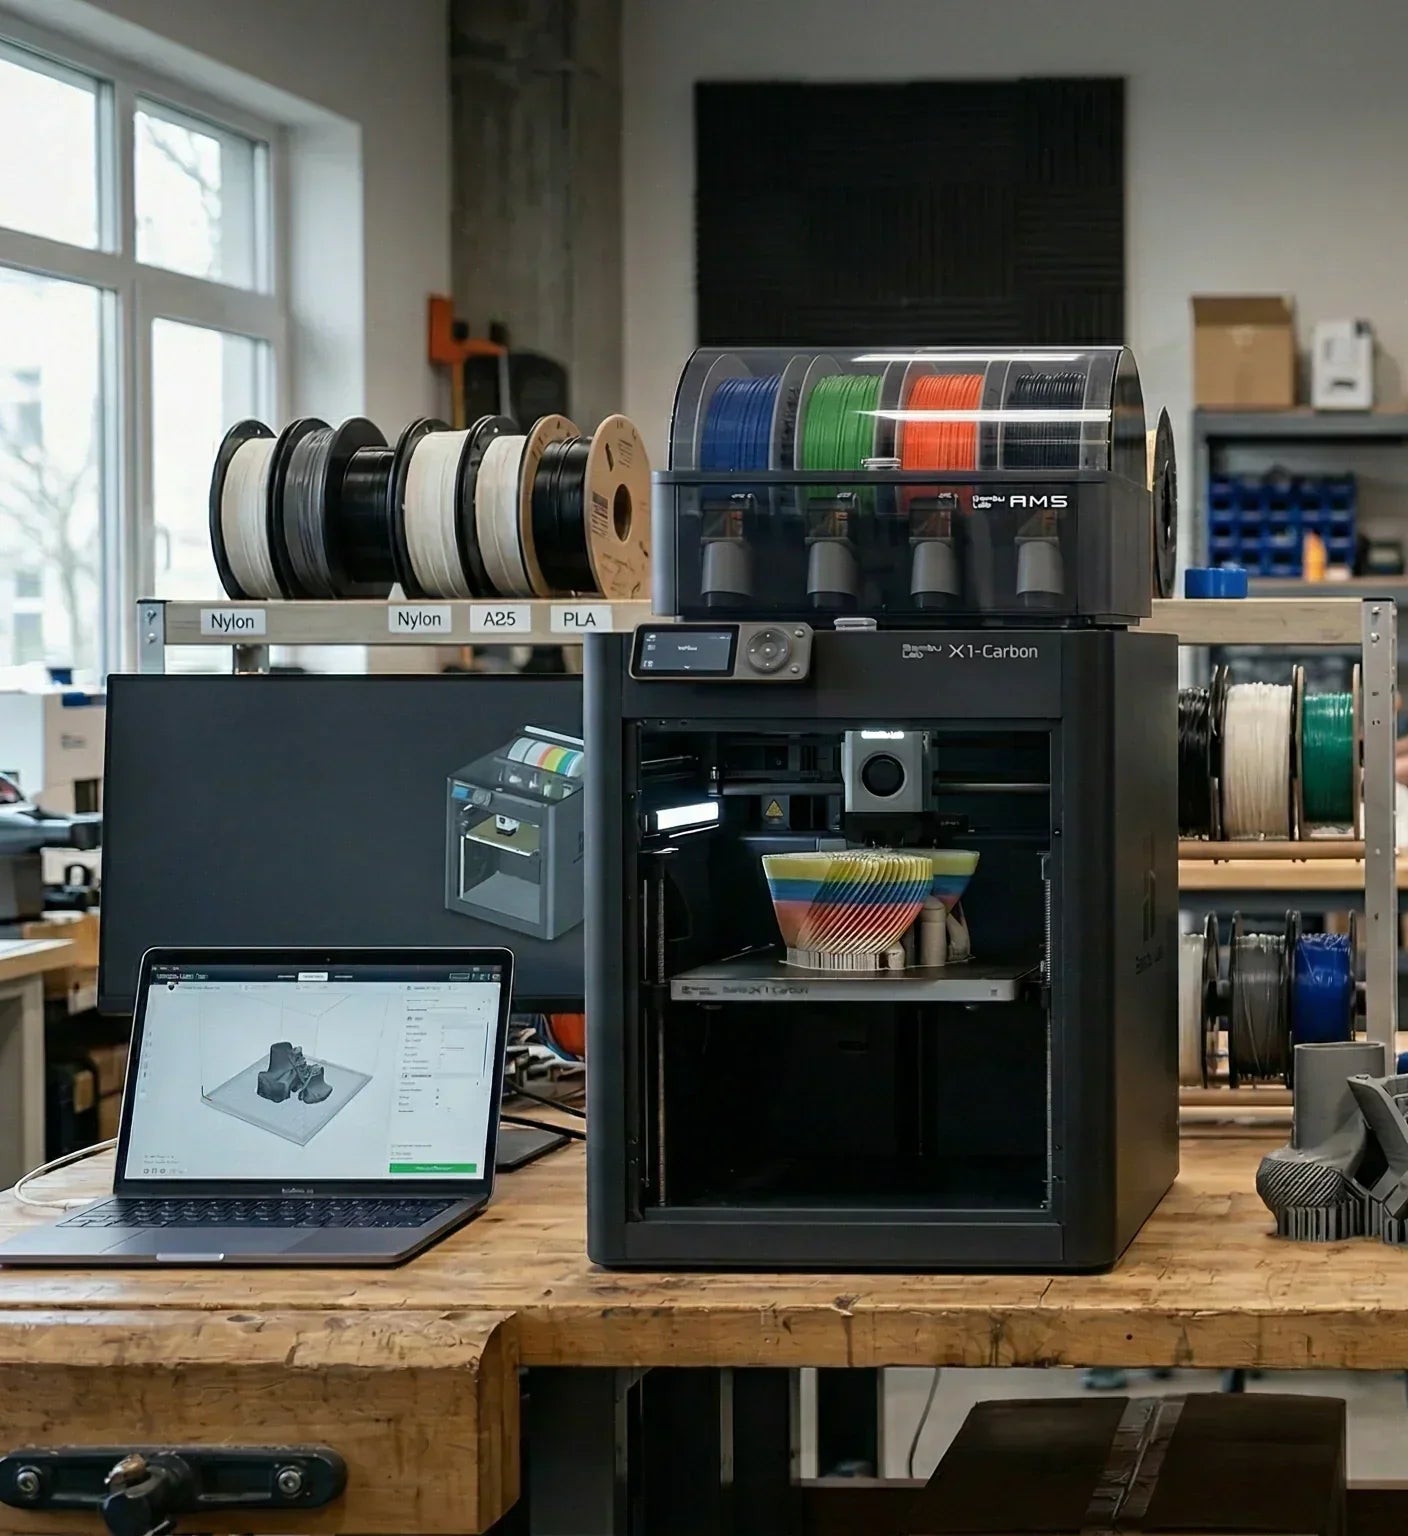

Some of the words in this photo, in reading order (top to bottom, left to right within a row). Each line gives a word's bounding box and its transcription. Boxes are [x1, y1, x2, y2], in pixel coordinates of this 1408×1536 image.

[1009, 495, 1068, 508] AMS
[211, 613, 255, 630] Nylon
[398, 611, 442, 629] Nylon
[483, 611, 516, 627] A25
[563, 611, 597, 627] PLA
